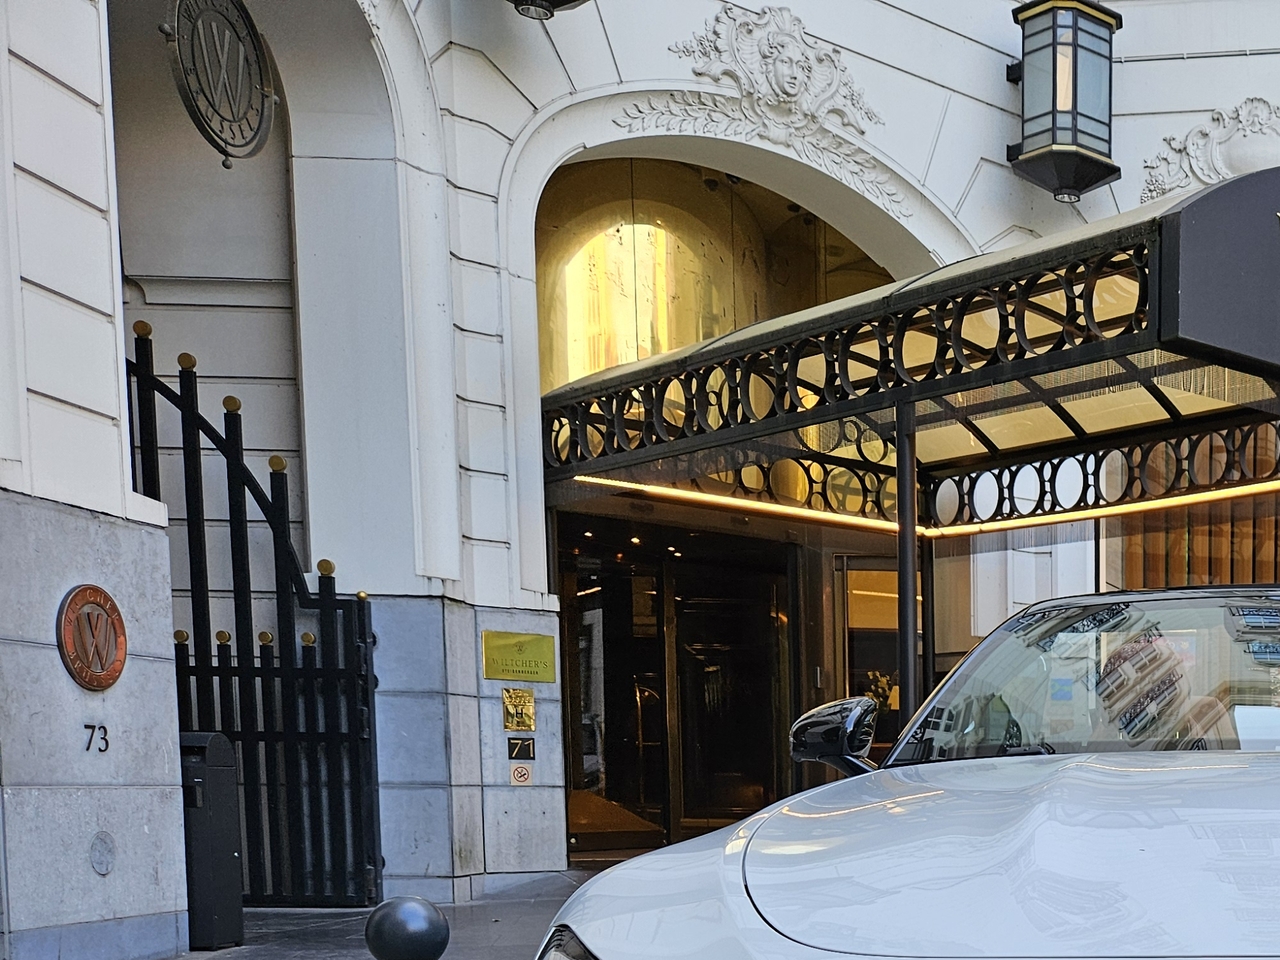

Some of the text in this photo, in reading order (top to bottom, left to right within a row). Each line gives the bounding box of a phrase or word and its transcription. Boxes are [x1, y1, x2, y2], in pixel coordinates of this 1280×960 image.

[492, 658, 548, 668] WILTCHER'S
[516, 709, 523, 718] H
[84, 724, 109, 753] 73
[510, 739, 534, 757] 71
